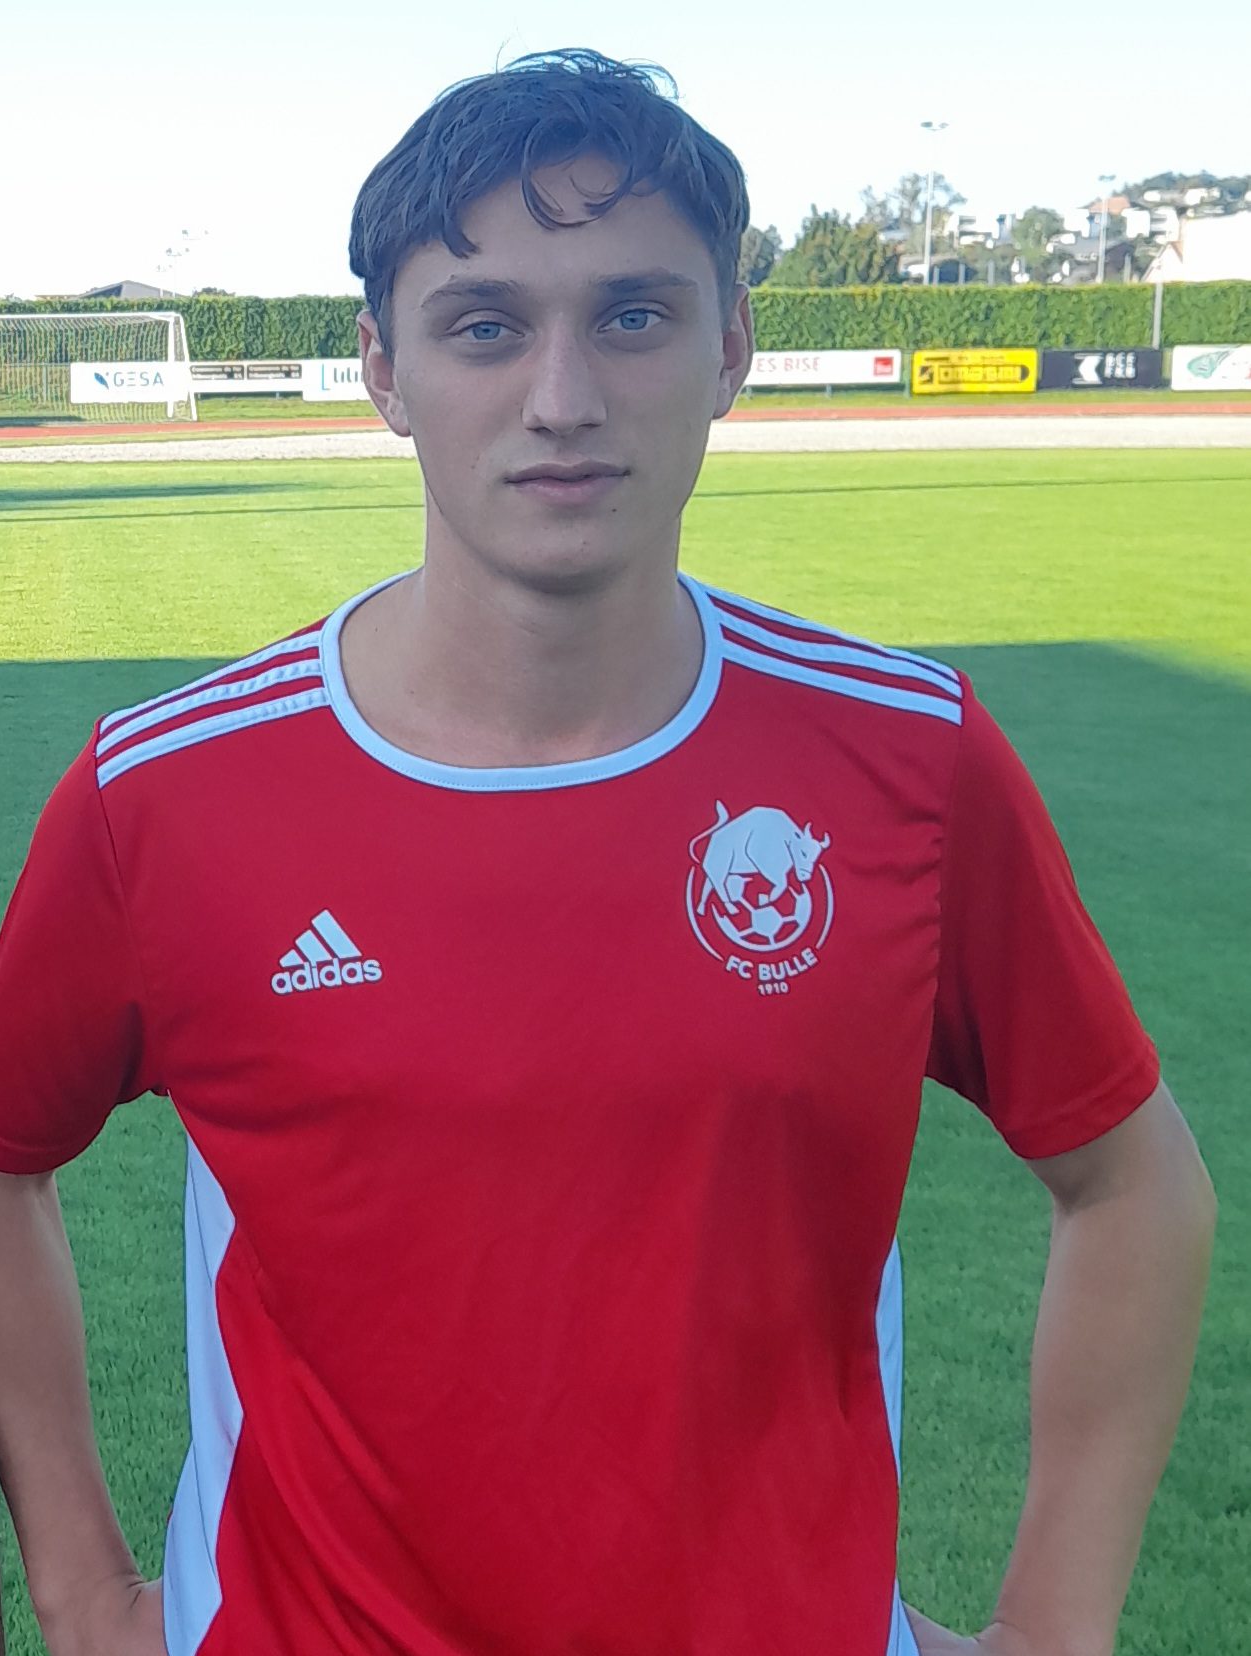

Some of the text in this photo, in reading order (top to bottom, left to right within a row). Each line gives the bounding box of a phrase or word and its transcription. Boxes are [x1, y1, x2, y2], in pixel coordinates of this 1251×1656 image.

[113, 371, 165, 387] GESA
[271, 957, 383, 995] adidas
[725, 947, 819, 981] FC BULLE
[758, 981, 789, 996] 1910
